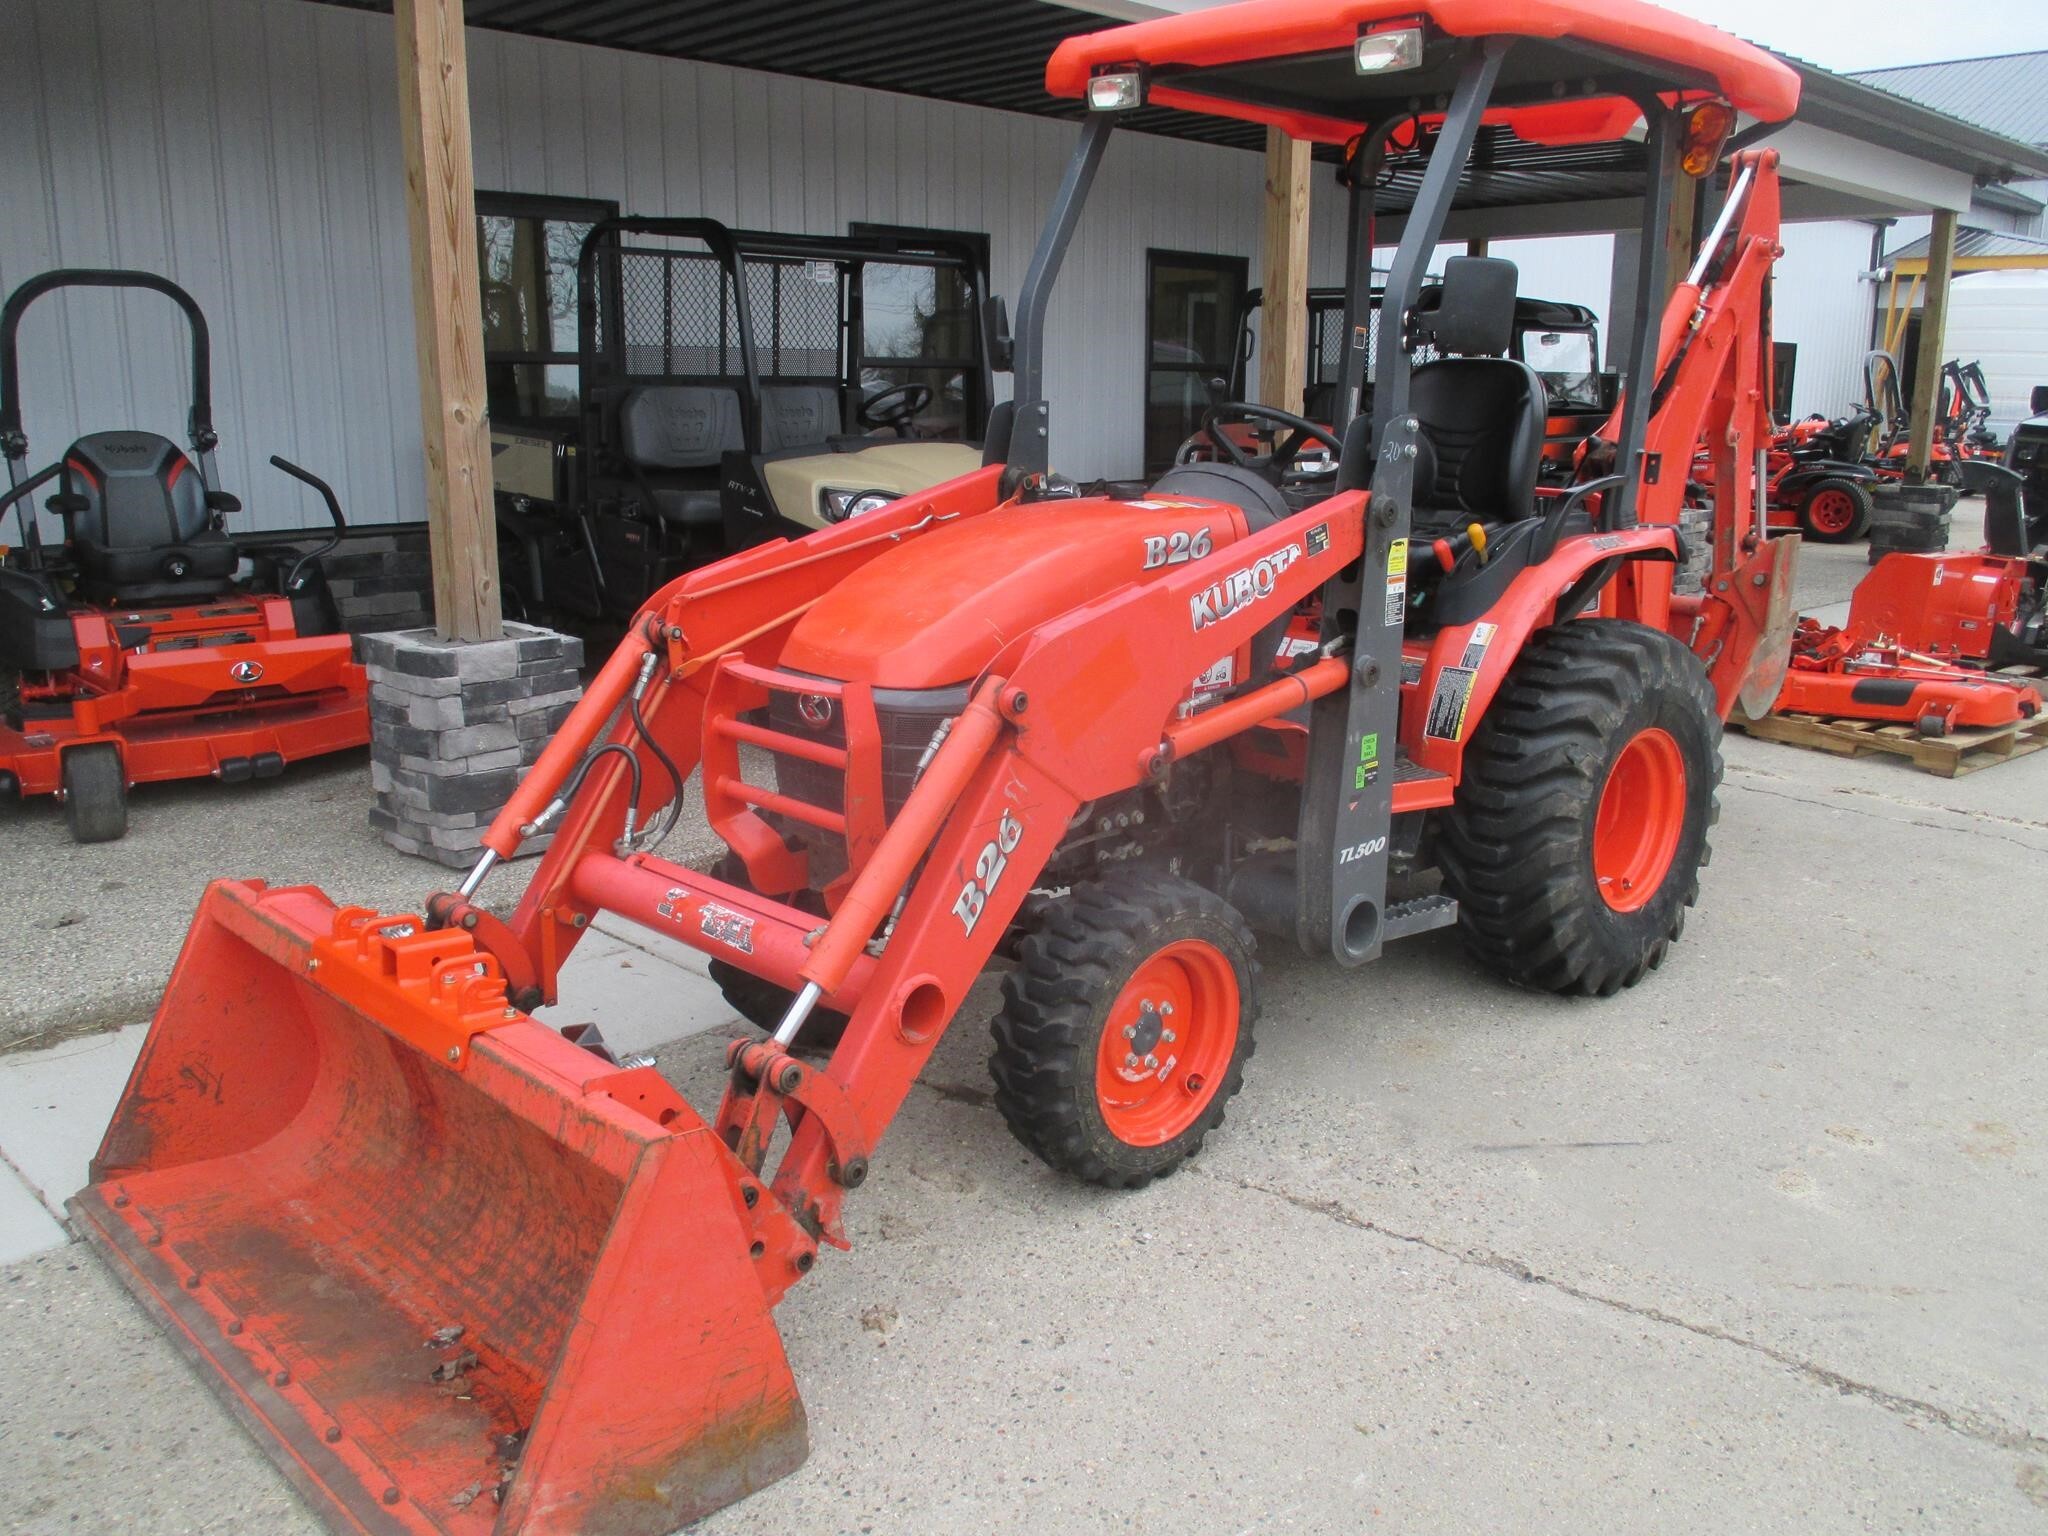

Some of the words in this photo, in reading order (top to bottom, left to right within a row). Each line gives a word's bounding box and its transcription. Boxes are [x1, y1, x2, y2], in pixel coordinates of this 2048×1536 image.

[1143, 527, 1212, 571] B26
[1339, 836, 1386, 865] TL500
[952, 807, 1024, 939] B26
